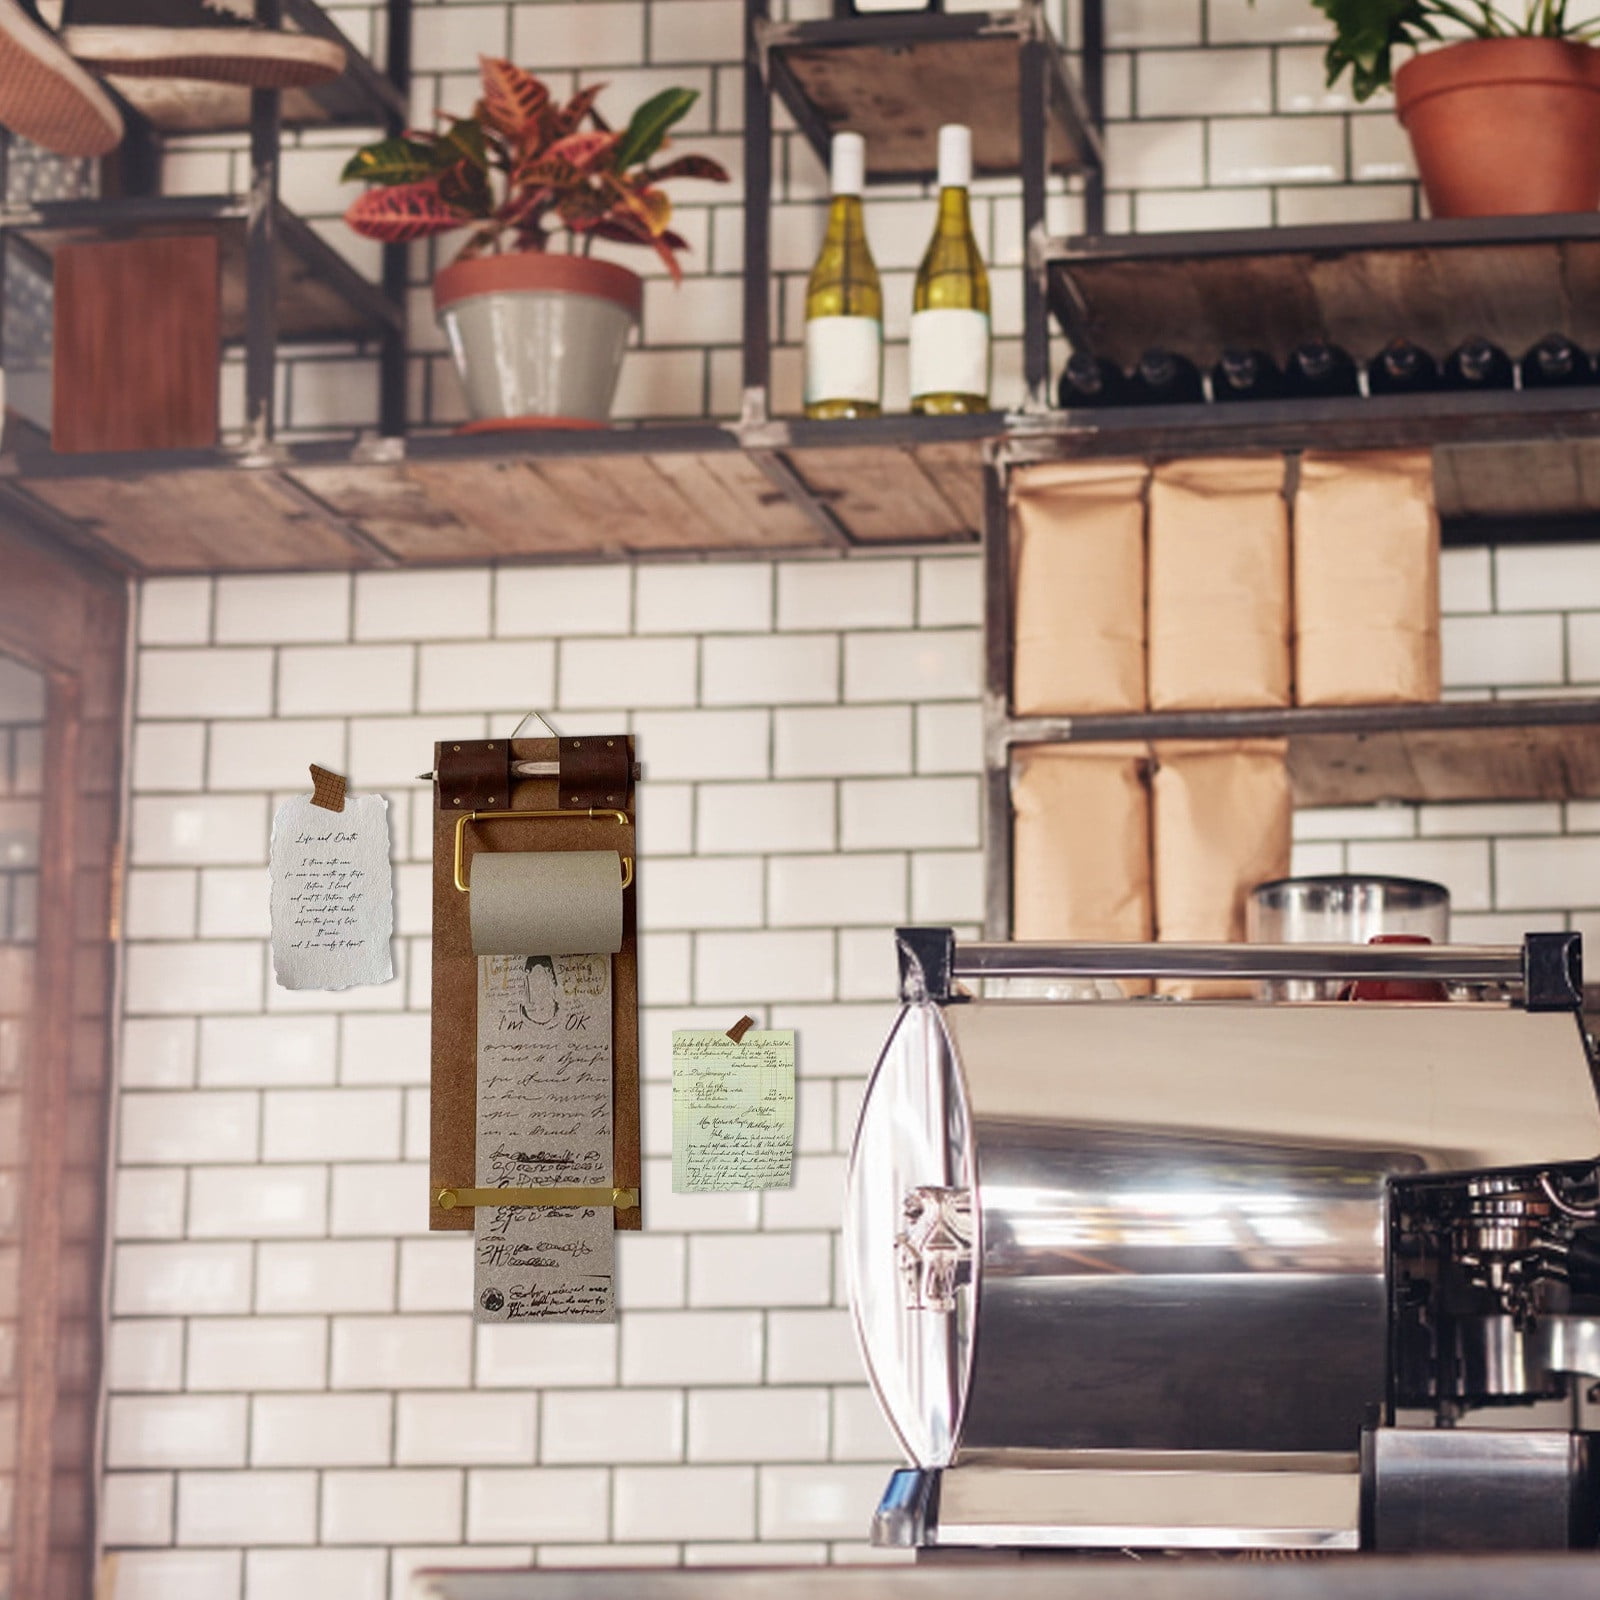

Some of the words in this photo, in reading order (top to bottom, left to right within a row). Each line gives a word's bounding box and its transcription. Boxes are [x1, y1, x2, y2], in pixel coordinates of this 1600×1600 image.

[295, 832, 314, 844] Life
[317, 832, 332, 843] and
[334, 832, 358, 843] Death
[565, 1014, 590, 1031] OK
